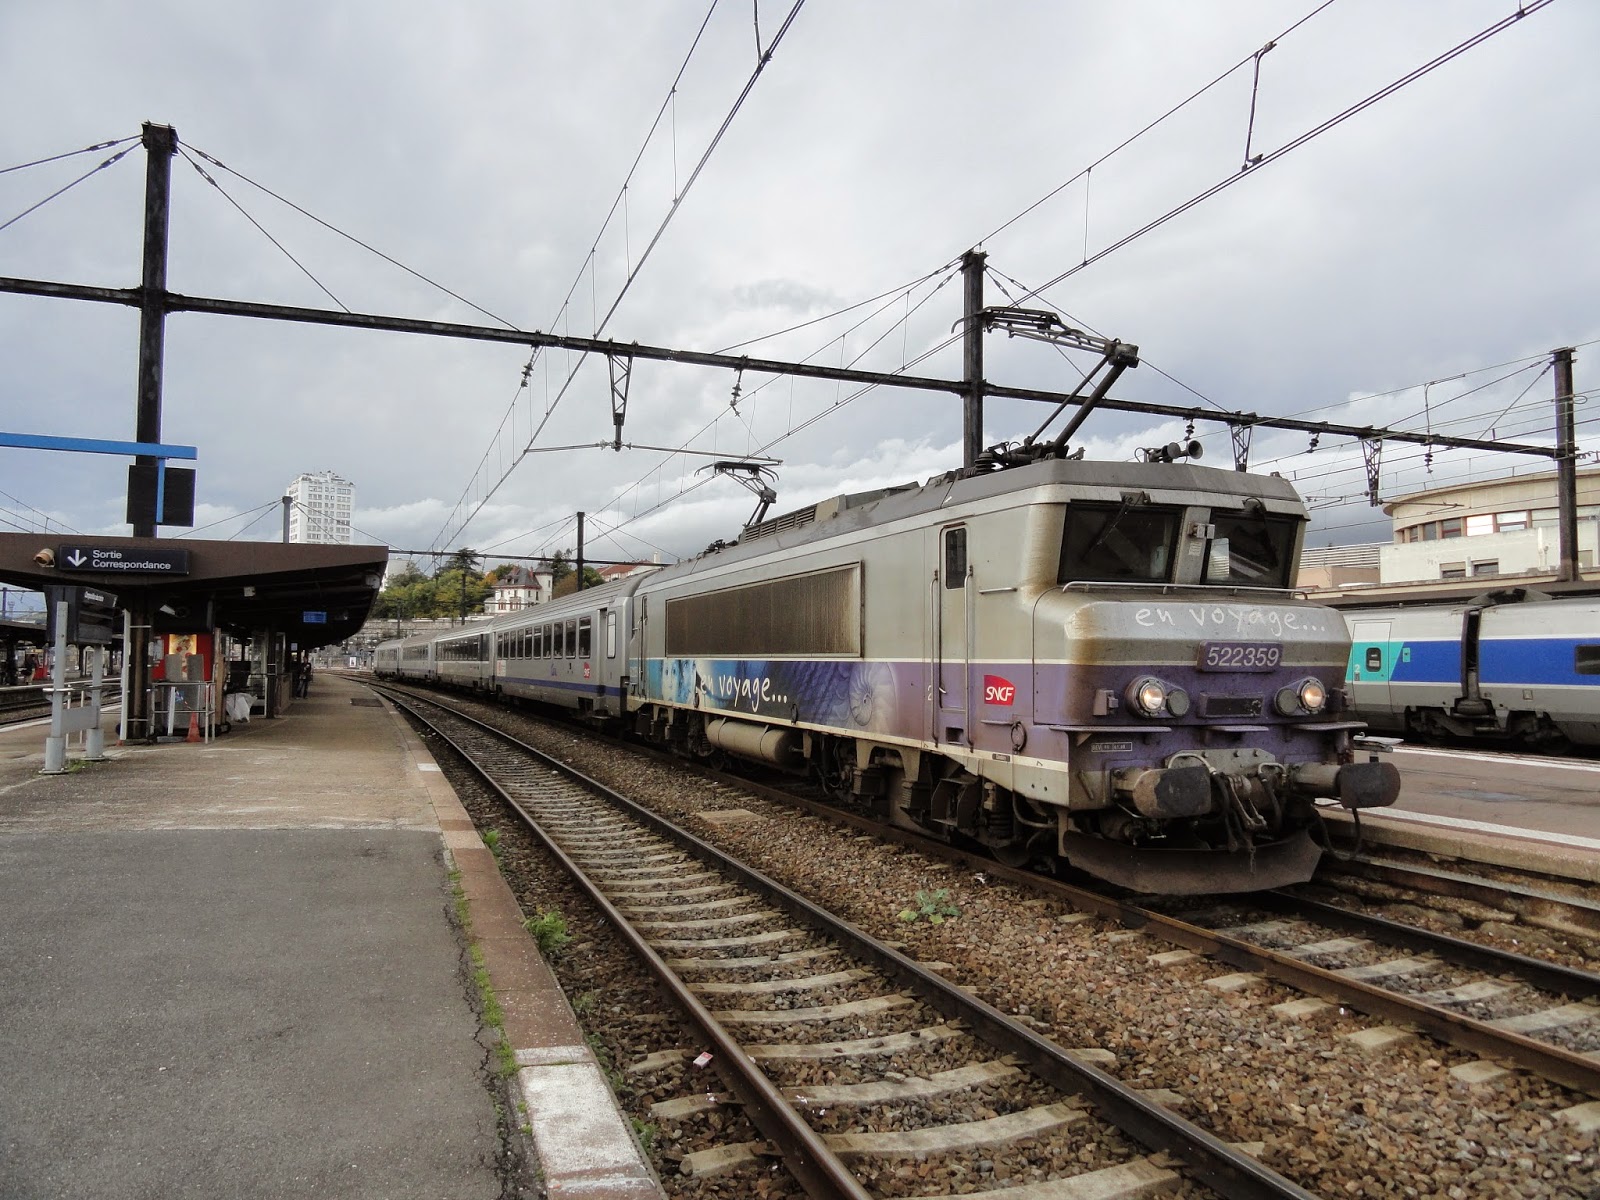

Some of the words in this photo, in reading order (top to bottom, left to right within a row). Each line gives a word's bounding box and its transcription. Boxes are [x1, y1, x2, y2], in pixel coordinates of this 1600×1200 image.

[92, 549, 122, 559] Sortie
[92, 559, 171, 570] Correspondance
[1135, 608, 1175, 627] en
[1189, 607, 1326, 637] voyage...
[1207, 647, 1279, 667] 522359
[700, 674, 714, 695] en
[718, 673, 788, 713] voyage...
[985, 686, 1014, 702] SNCF
